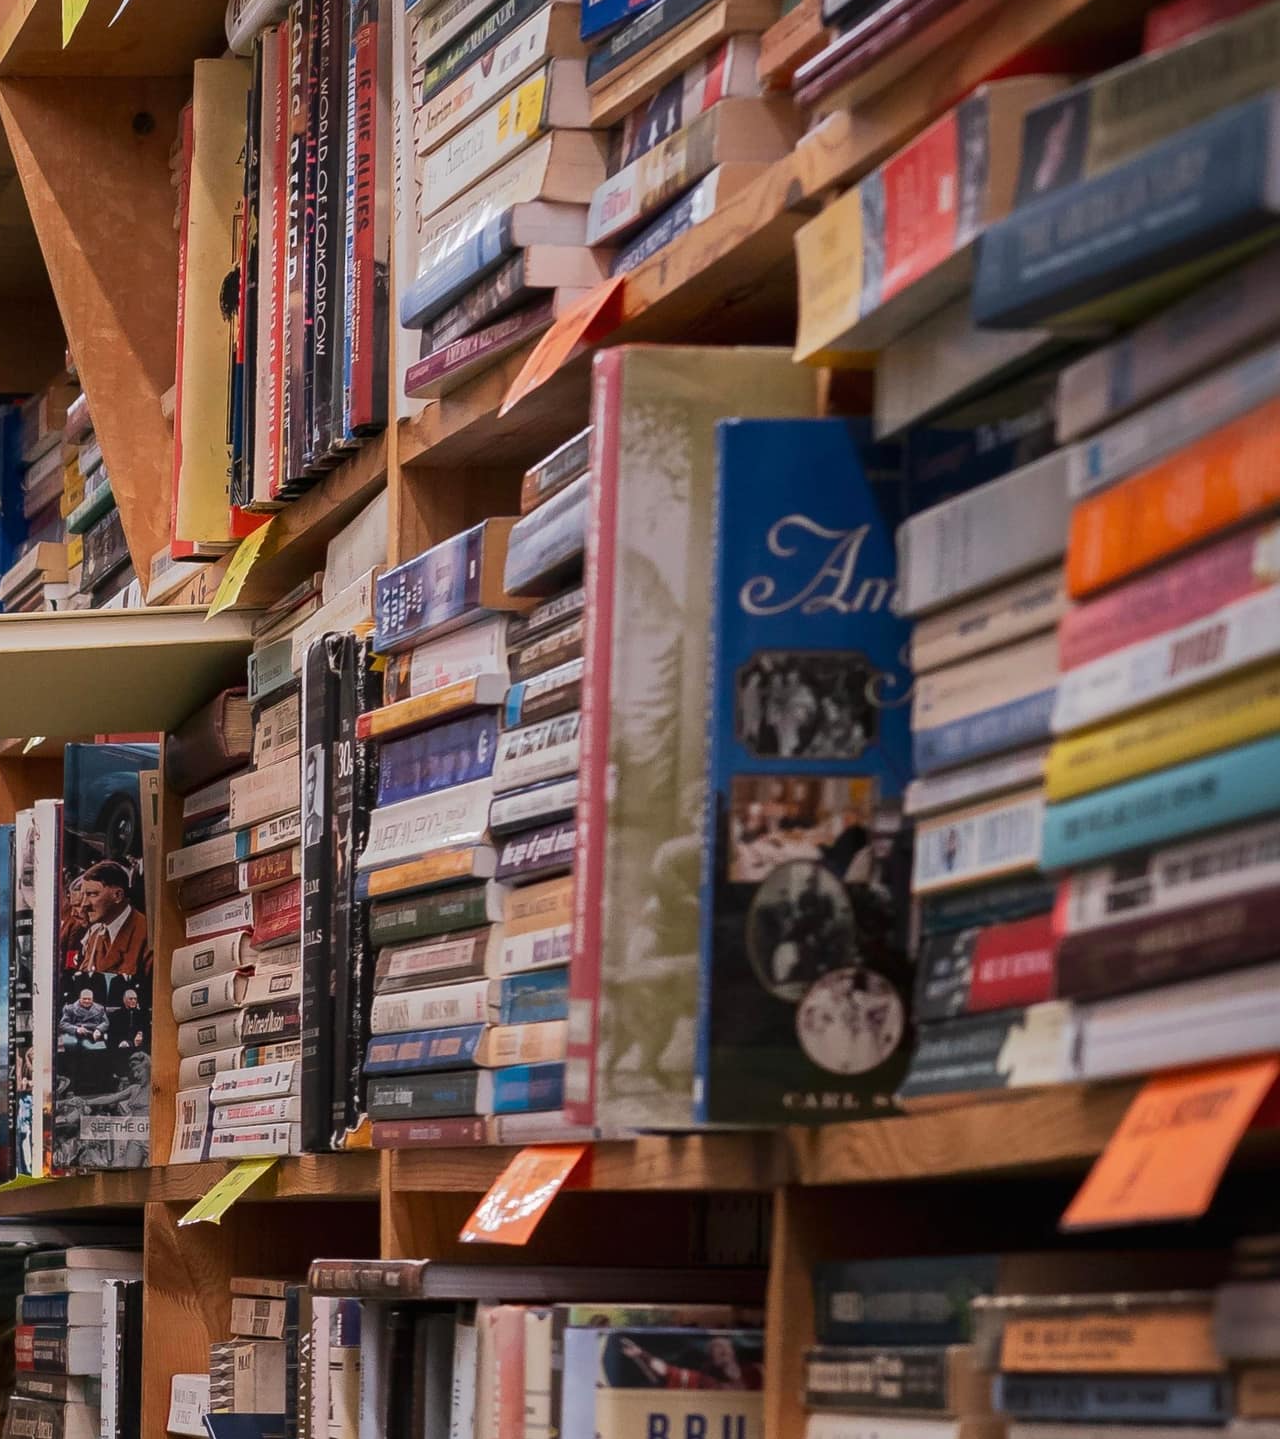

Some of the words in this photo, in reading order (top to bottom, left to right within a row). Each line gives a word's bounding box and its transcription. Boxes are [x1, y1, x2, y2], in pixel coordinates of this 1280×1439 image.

[360, 68, 371, 91] IF
[358, 96, 371, 142] THE
[356, 147, 371, 233] ALLIES
[90, 1122, 111, 1133] SEE
[113, 1122, 135, 1133] THE
